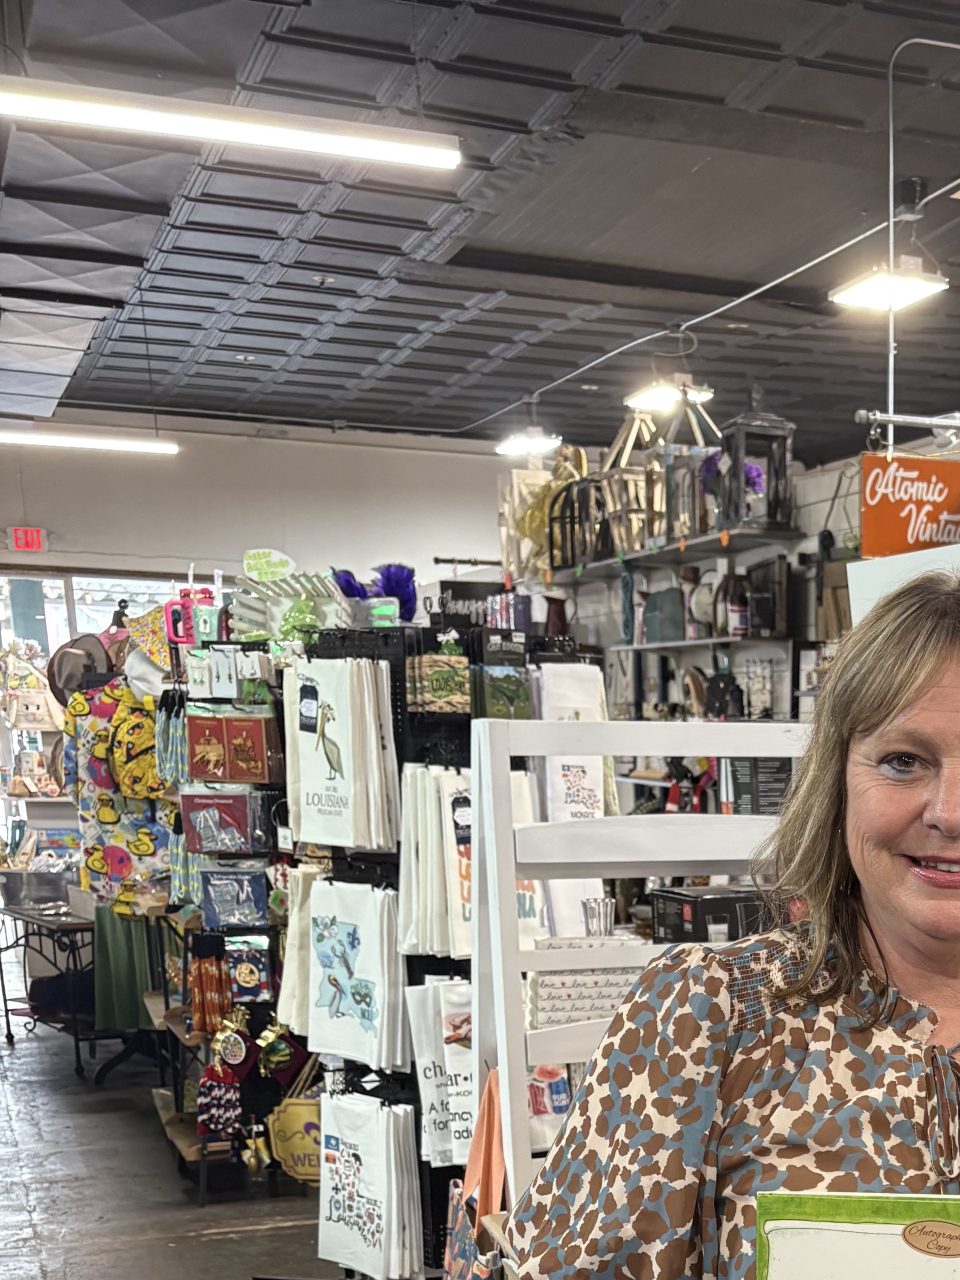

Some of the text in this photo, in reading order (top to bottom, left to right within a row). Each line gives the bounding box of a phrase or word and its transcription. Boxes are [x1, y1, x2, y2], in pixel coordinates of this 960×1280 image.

[865, 462, 949, 505] Atomic
[13, 528, 43, 550] EXIT
[306, 792, 349, 809] LOUISIANA
[926, 1239, 952, 1253] Copy
